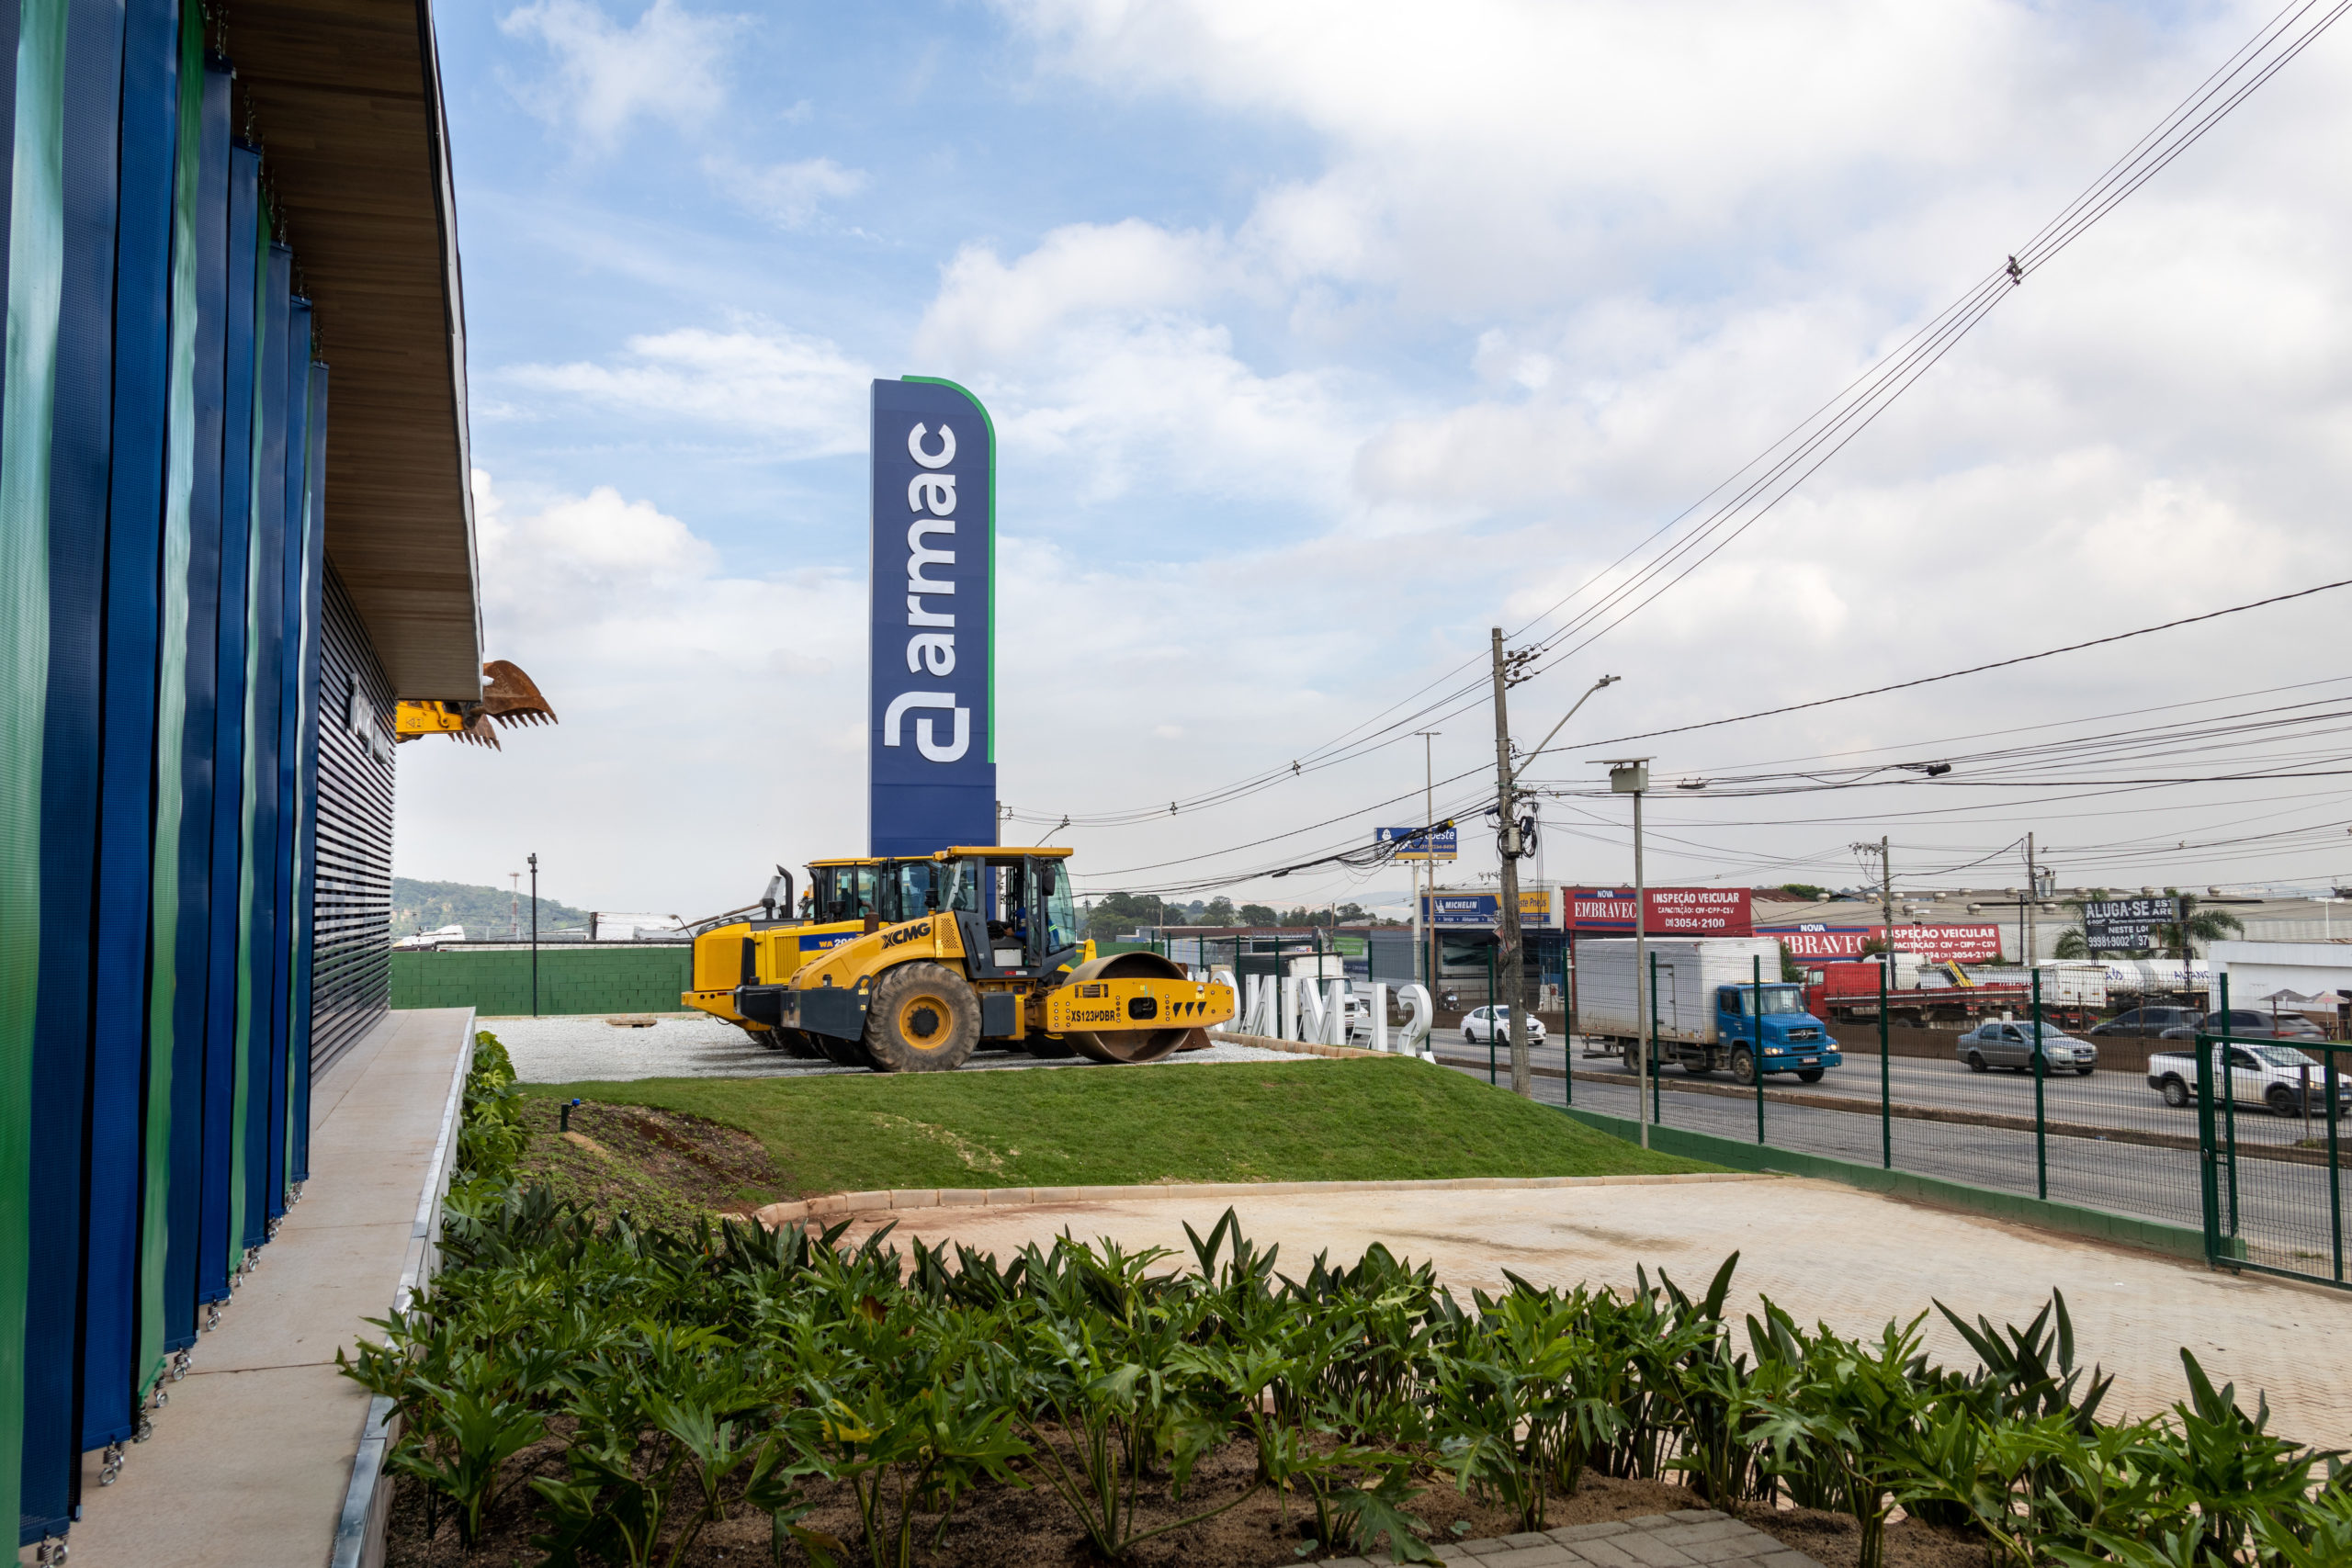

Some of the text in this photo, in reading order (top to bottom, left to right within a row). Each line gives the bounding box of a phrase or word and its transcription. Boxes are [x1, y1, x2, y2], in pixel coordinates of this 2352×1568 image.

[907, 422, 956, 677] armac
[1597, 890, 1614, 898] NOVA
[1653, 891, 1739, 906] INSPEÇÃO VEICULAR
[1445, 901, 1477, 909] MICHELIN
[1574, 902, 1637, 919] EMBRAVEC
[2086, 900, 2150, 919] ALUGA-SE
[881, 922, 931, 950] XCMG
[1881, 927, 1996, 942] ISPEÇÃO VEICULAR
[2108, 926, 2133, 934] NESTE
[1781, 935, 1871, 954] MBRAVEC
[1883, 941, 1939, 951] PACITAÇÃO:
[2138, 934, 2148, 946] 97
[1071, 1010, 1115, 1022] XS123PDBR
